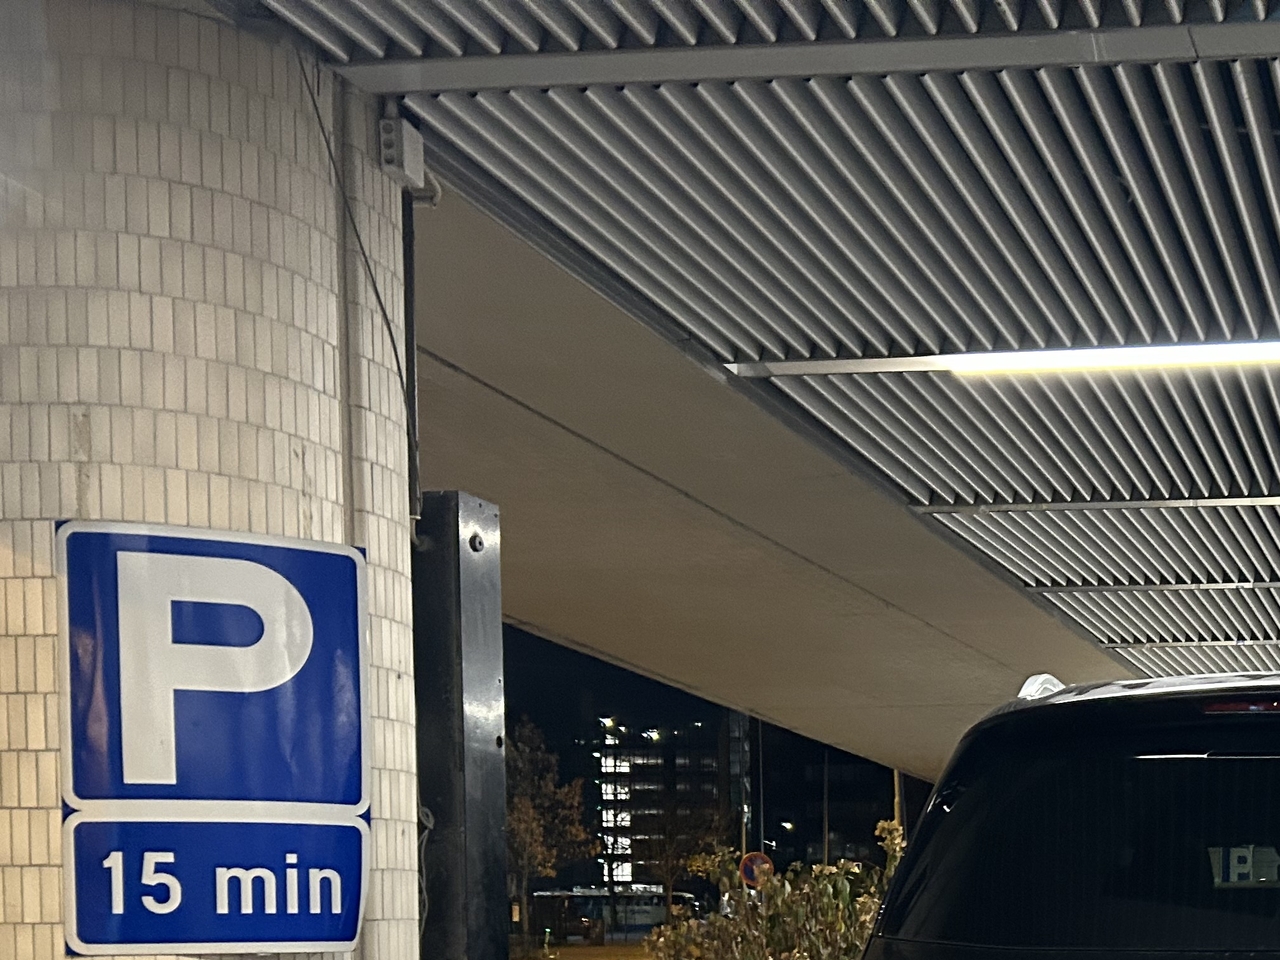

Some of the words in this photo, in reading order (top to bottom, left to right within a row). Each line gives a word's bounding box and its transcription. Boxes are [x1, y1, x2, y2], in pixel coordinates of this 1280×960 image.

[116, 551, 314, 785] P
[102, 851, 182, 915] 15
[215, 853, 342, 915] min
